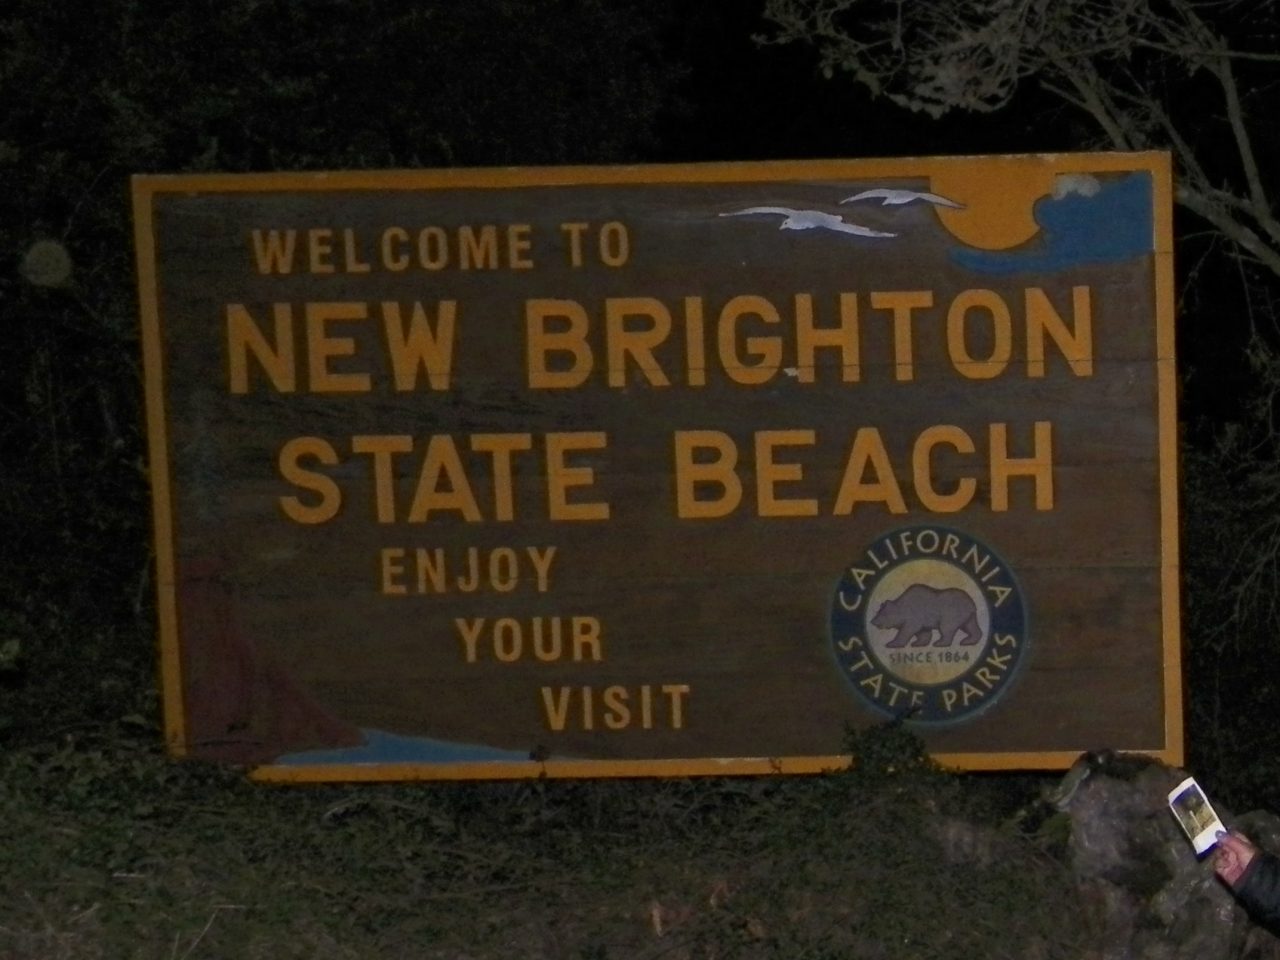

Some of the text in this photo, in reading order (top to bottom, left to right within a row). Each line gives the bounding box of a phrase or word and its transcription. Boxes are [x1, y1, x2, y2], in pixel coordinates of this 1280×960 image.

[252, 220, 630, 275] WELCOME TO
[225, 285, 1093, 394] NEW BRIGHTON
[277, 420, 1054, 525] STATE BEACH
[380, 546, 557, 595] ENJOY
[839, 529, 1013, 612] CALIFORNIA
[454, 616, 603, 663] YOUR
[890, 652, 932, 663] SINCE
[838, 633, 1017, 715] STATE PARKS
[541, 684, 690, 731] VISIT
